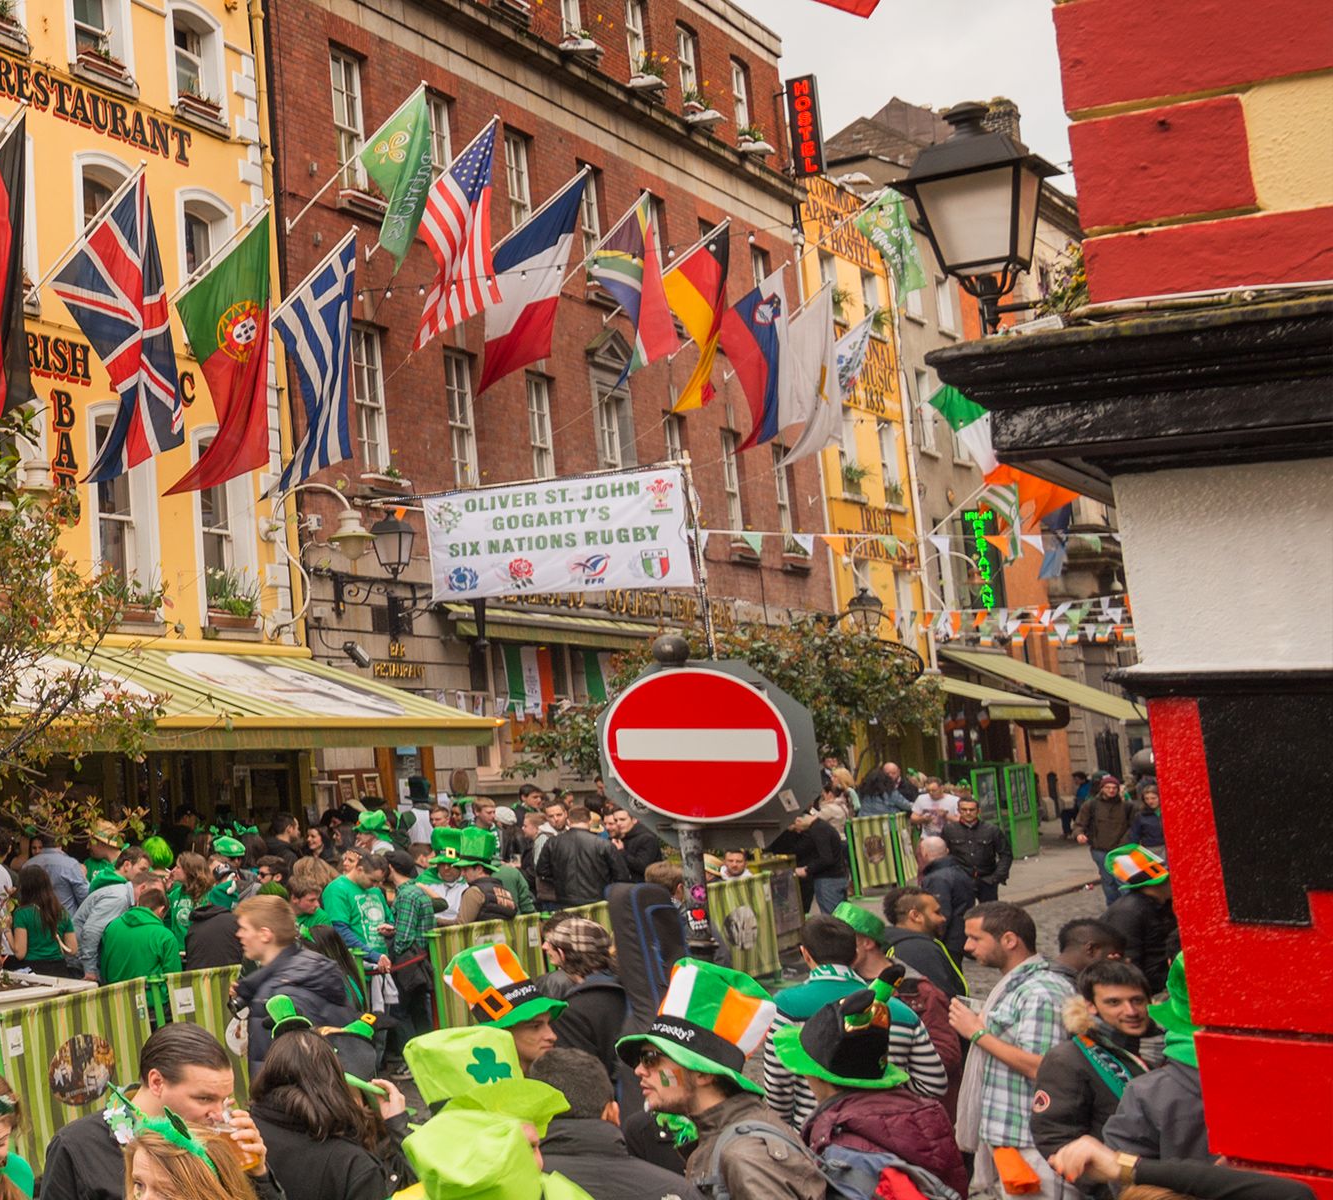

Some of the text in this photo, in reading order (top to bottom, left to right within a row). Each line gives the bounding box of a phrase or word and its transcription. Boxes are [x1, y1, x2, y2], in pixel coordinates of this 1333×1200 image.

[793, 78, 819, 174] HOSTEL
[831, 231, 875, 270] HOSTEL
[464, 480, 640, 514] OLIVER ST. JOHN
[492, 505, 611, 532] GOGARTY'S
[449, 525, 660, 558] SIX NATIONS RUGBY
